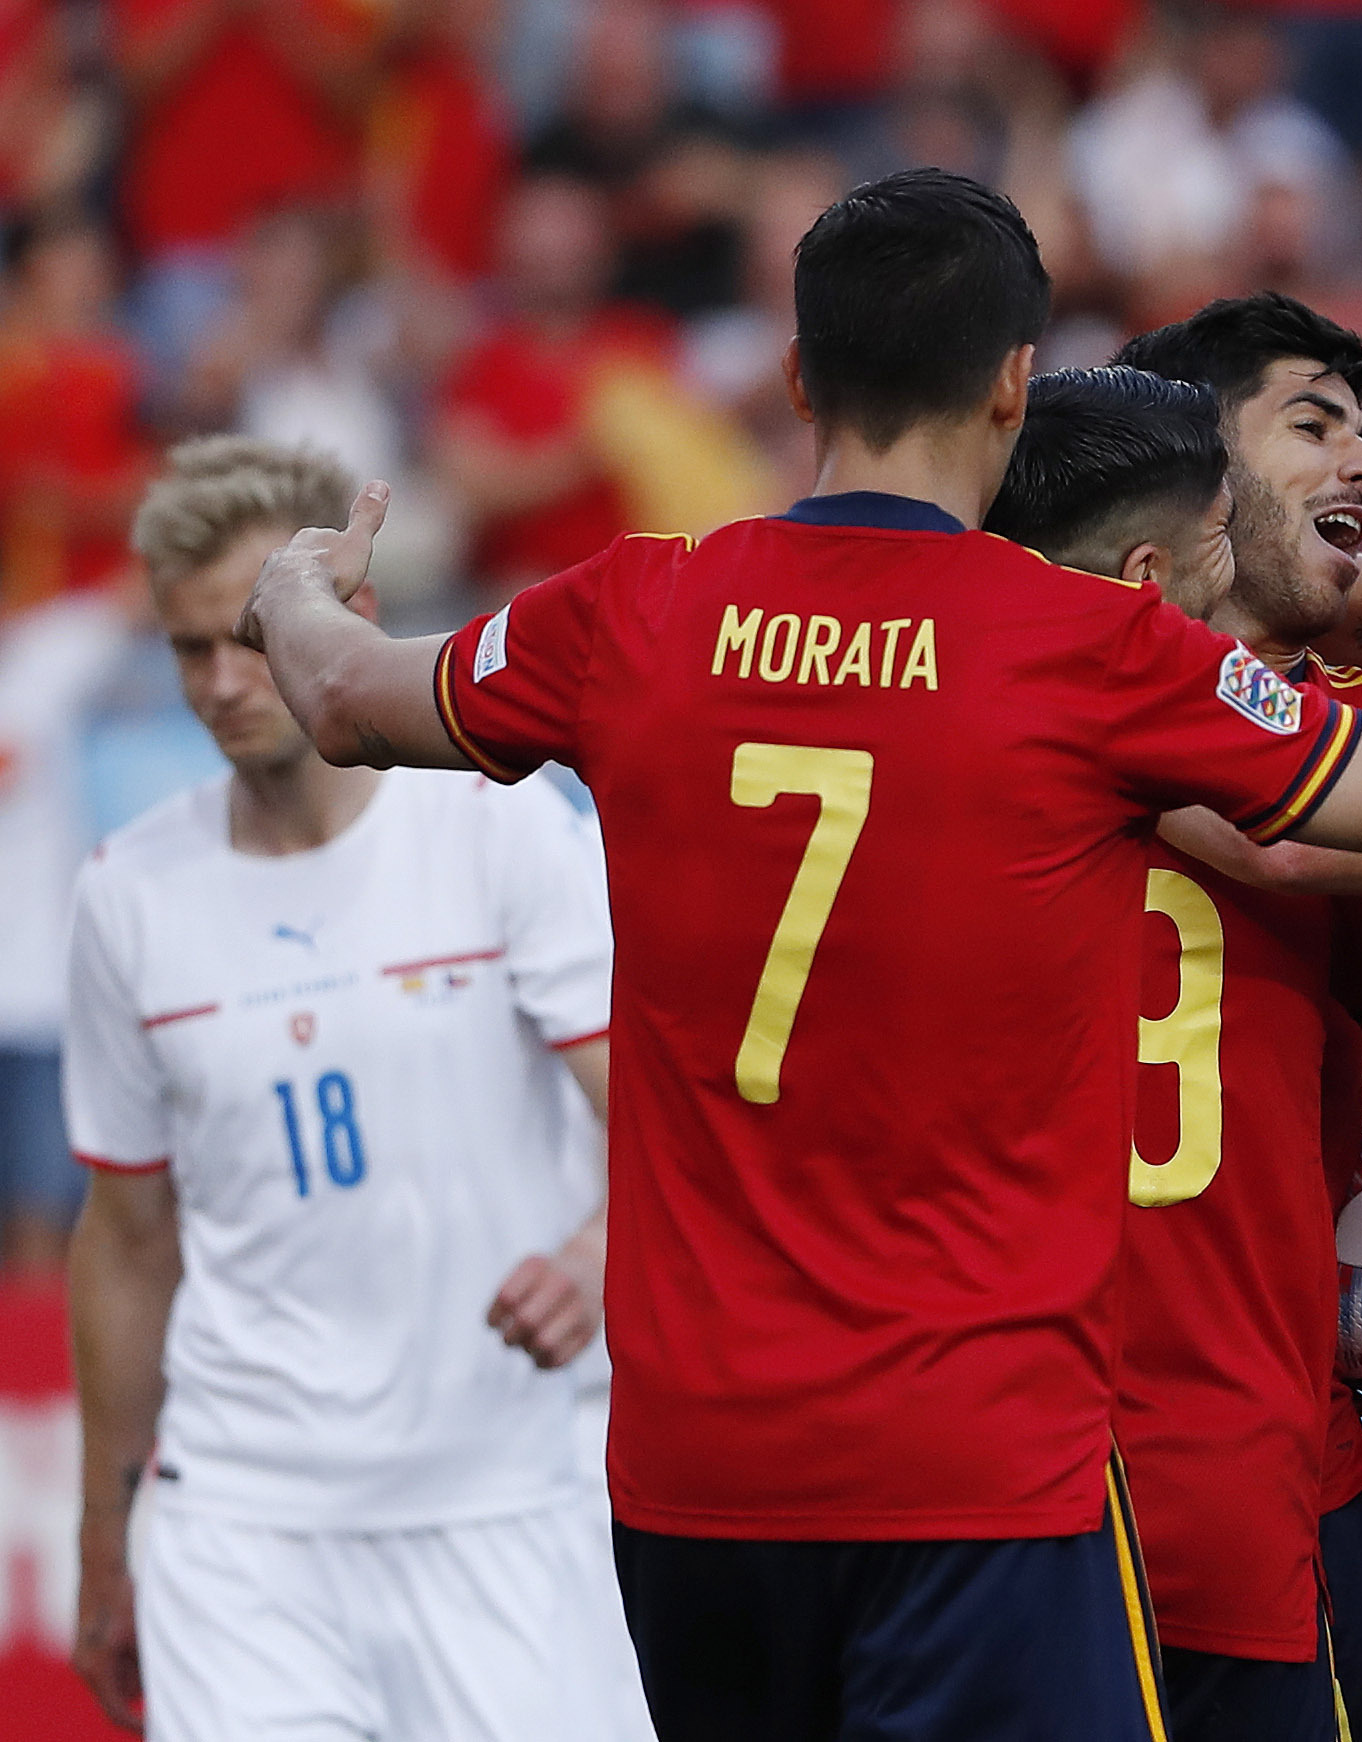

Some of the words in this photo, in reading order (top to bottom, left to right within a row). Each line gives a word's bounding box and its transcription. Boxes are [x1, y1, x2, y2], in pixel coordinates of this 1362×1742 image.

[711, 604, 938, 690] MORATA
[731, 742, 874, 1104] 7
[275, 1070, 366, 1198] 18
